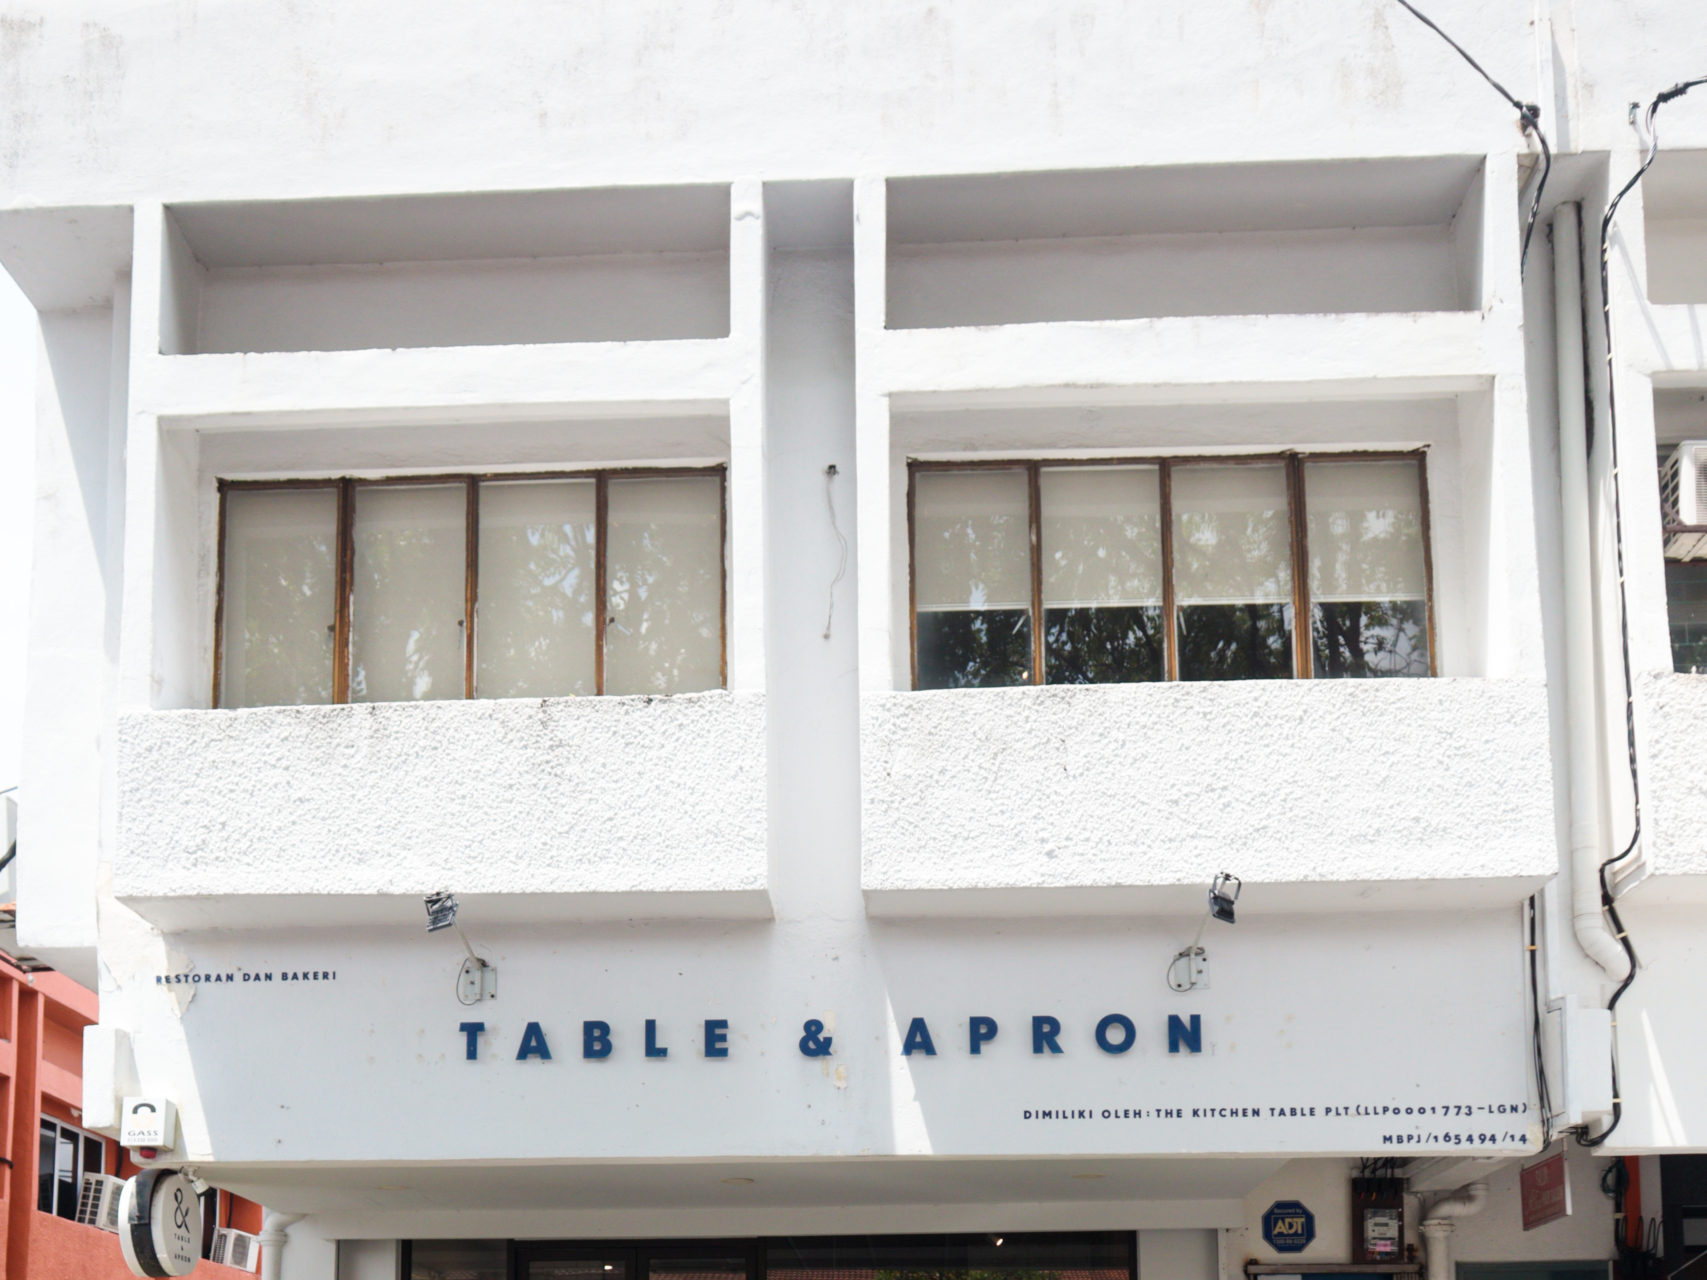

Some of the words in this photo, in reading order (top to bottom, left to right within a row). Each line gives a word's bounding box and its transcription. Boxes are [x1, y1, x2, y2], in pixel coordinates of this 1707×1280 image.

[156, 973, 234, 984] RESTORAN
[242, 972, 272, 982] DAN
[281, 971, 336, 981] BAKERI
[459, 1019, 729, 1061] TABLE
[798, 1018, 833, 1057] &
[900, 1013, 1202, 1056] APRON
[1023, 1109, 1093, 1120] DIMILIKI
[1155, 1108, 1183, 1118] THE
[1192, 1107, 1261, 1118] KITCHEN
[1269, 1107, 1316, 1117] TABLE
[1383, 1131, 1528, 1145] MBPJ/165494/14
[1273, 1217, 1305, 1235] ADT
